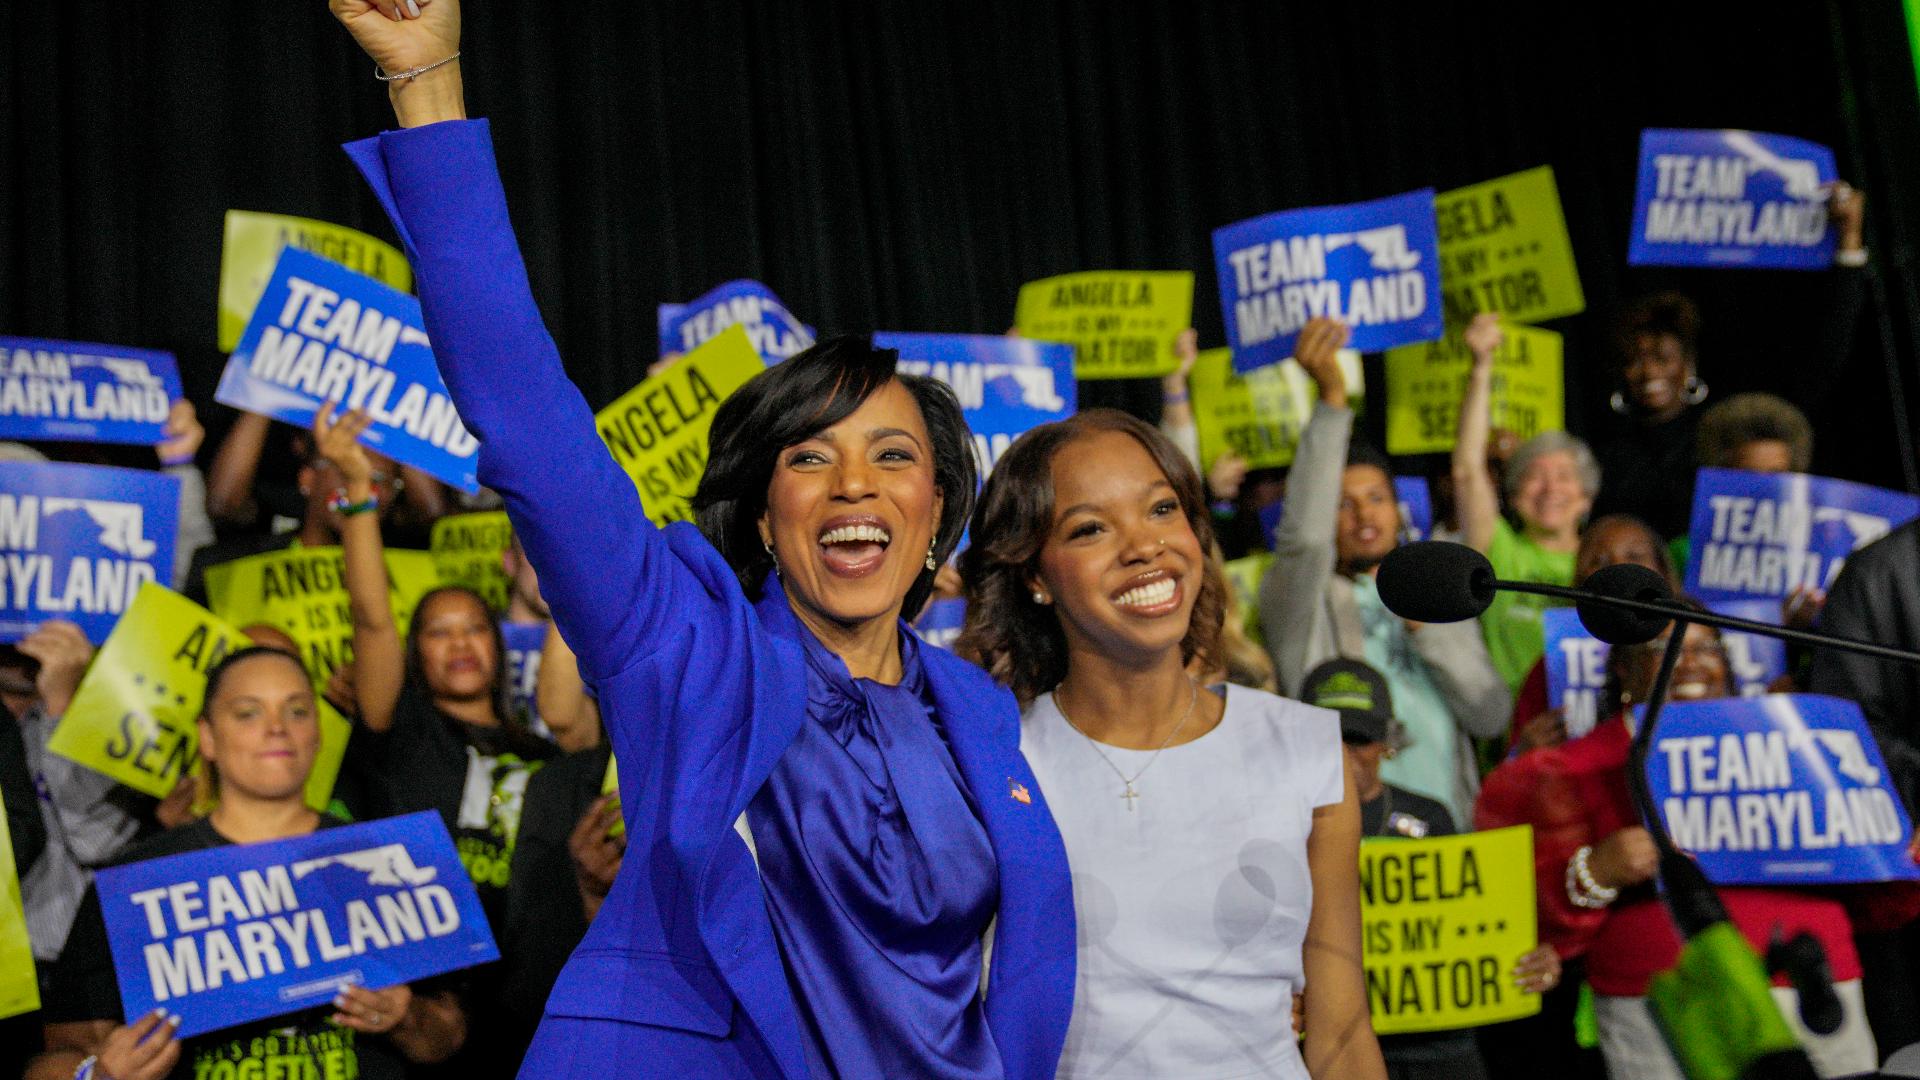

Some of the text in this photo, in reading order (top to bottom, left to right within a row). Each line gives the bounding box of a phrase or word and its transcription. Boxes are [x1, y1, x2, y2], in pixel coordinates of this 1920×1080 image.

[1654, 153, 1747, 200] TEAM
[1645, 199, 1828, 246] MARYLAND
[1230, 234, 1325, 296] TEAM
[277, 276, 402, 366] TEAM
[1235, 269, 1426, 347] MARYLAND
[0, 374, 170, 424] ARYLAND
[602, 366, 719, 464] NGELA
[641, 466, 670, 502] IS
[1659, 730, 1792, 794] TEAM
[1663, 786, 1902, 852] MARYLAND
[130, 864, 299, 939] TEAM
[1361, 847, 1483, 906] NGELA
[142, 884, 460, 1002] MARYLAND
[1367, 916, 1443, 955] IS MY
[1366, 954, 1502, 1016] NATOR
